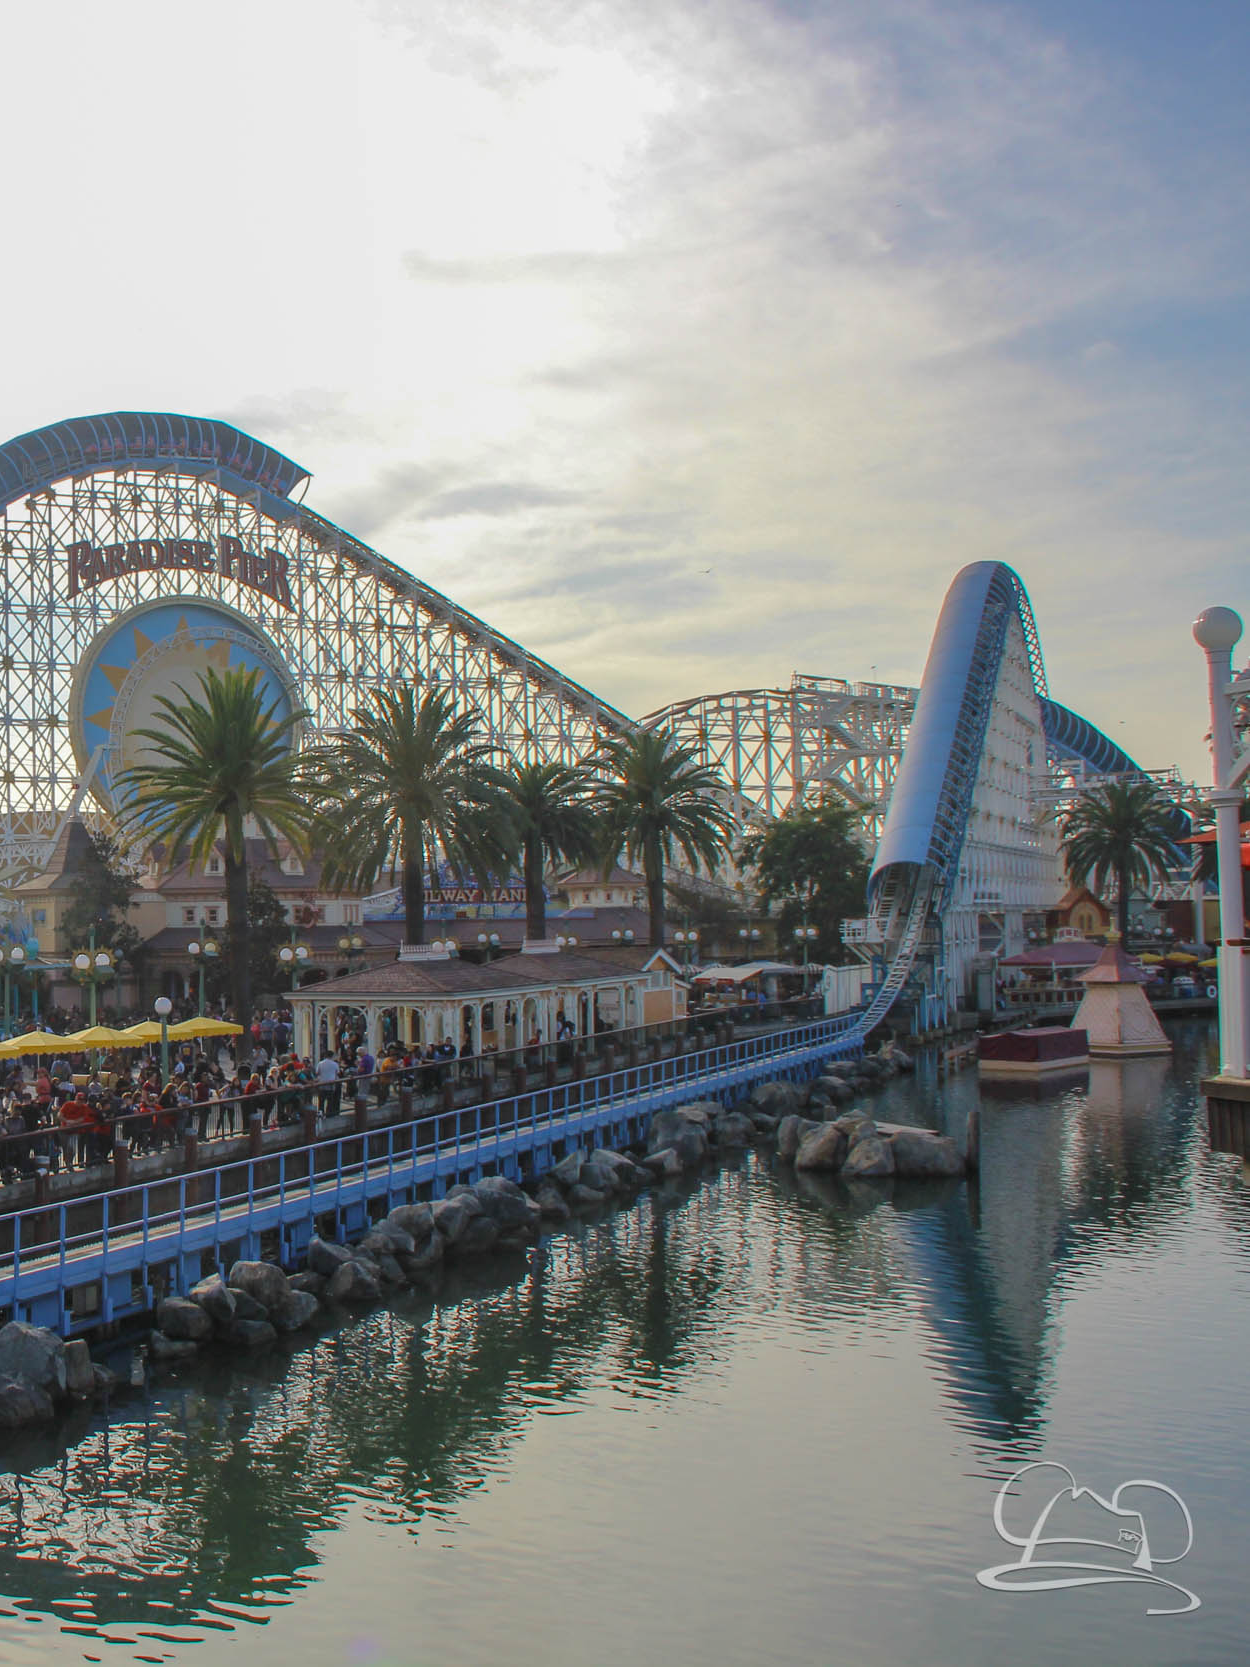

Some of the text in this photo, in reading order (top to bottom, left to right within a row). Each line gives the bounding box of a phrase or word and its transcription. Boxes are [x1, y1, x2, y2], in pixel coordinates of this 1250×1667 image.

[65, 533, 298, 615] PARADISE PIER
[423, 888, 478, 903] IDWAY
